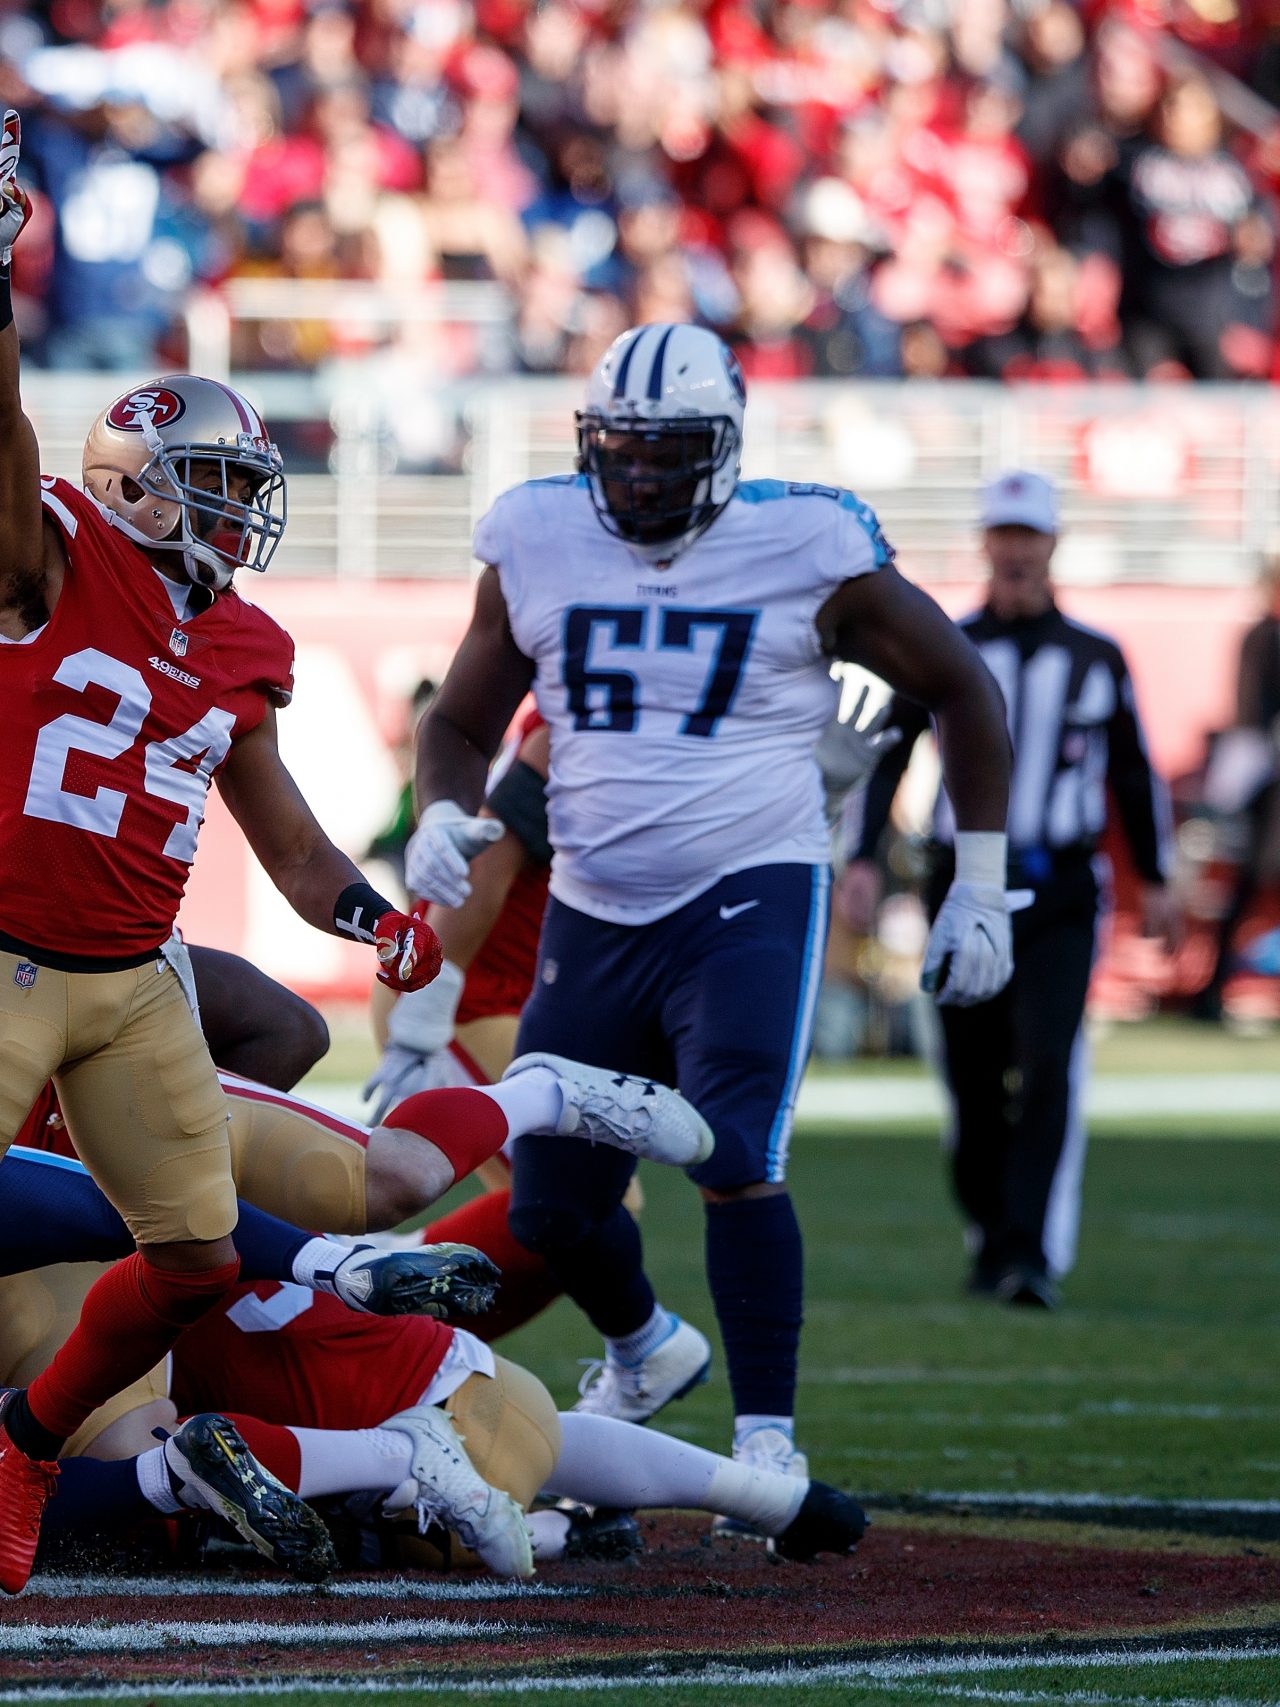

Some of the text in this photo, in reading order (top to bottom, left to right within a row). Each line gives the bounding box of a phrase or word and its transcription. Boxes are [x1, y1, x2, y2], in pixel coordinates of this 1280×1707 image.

[123, 391, 169, 426] SF
[637, 584, 679, 598] TITANS
[148, 656, 202, 689] 49ERS
[562, 603, 763, 736] 67
[23, 647, 237, 864] 24
[16, 971, 35, 986] NFL
